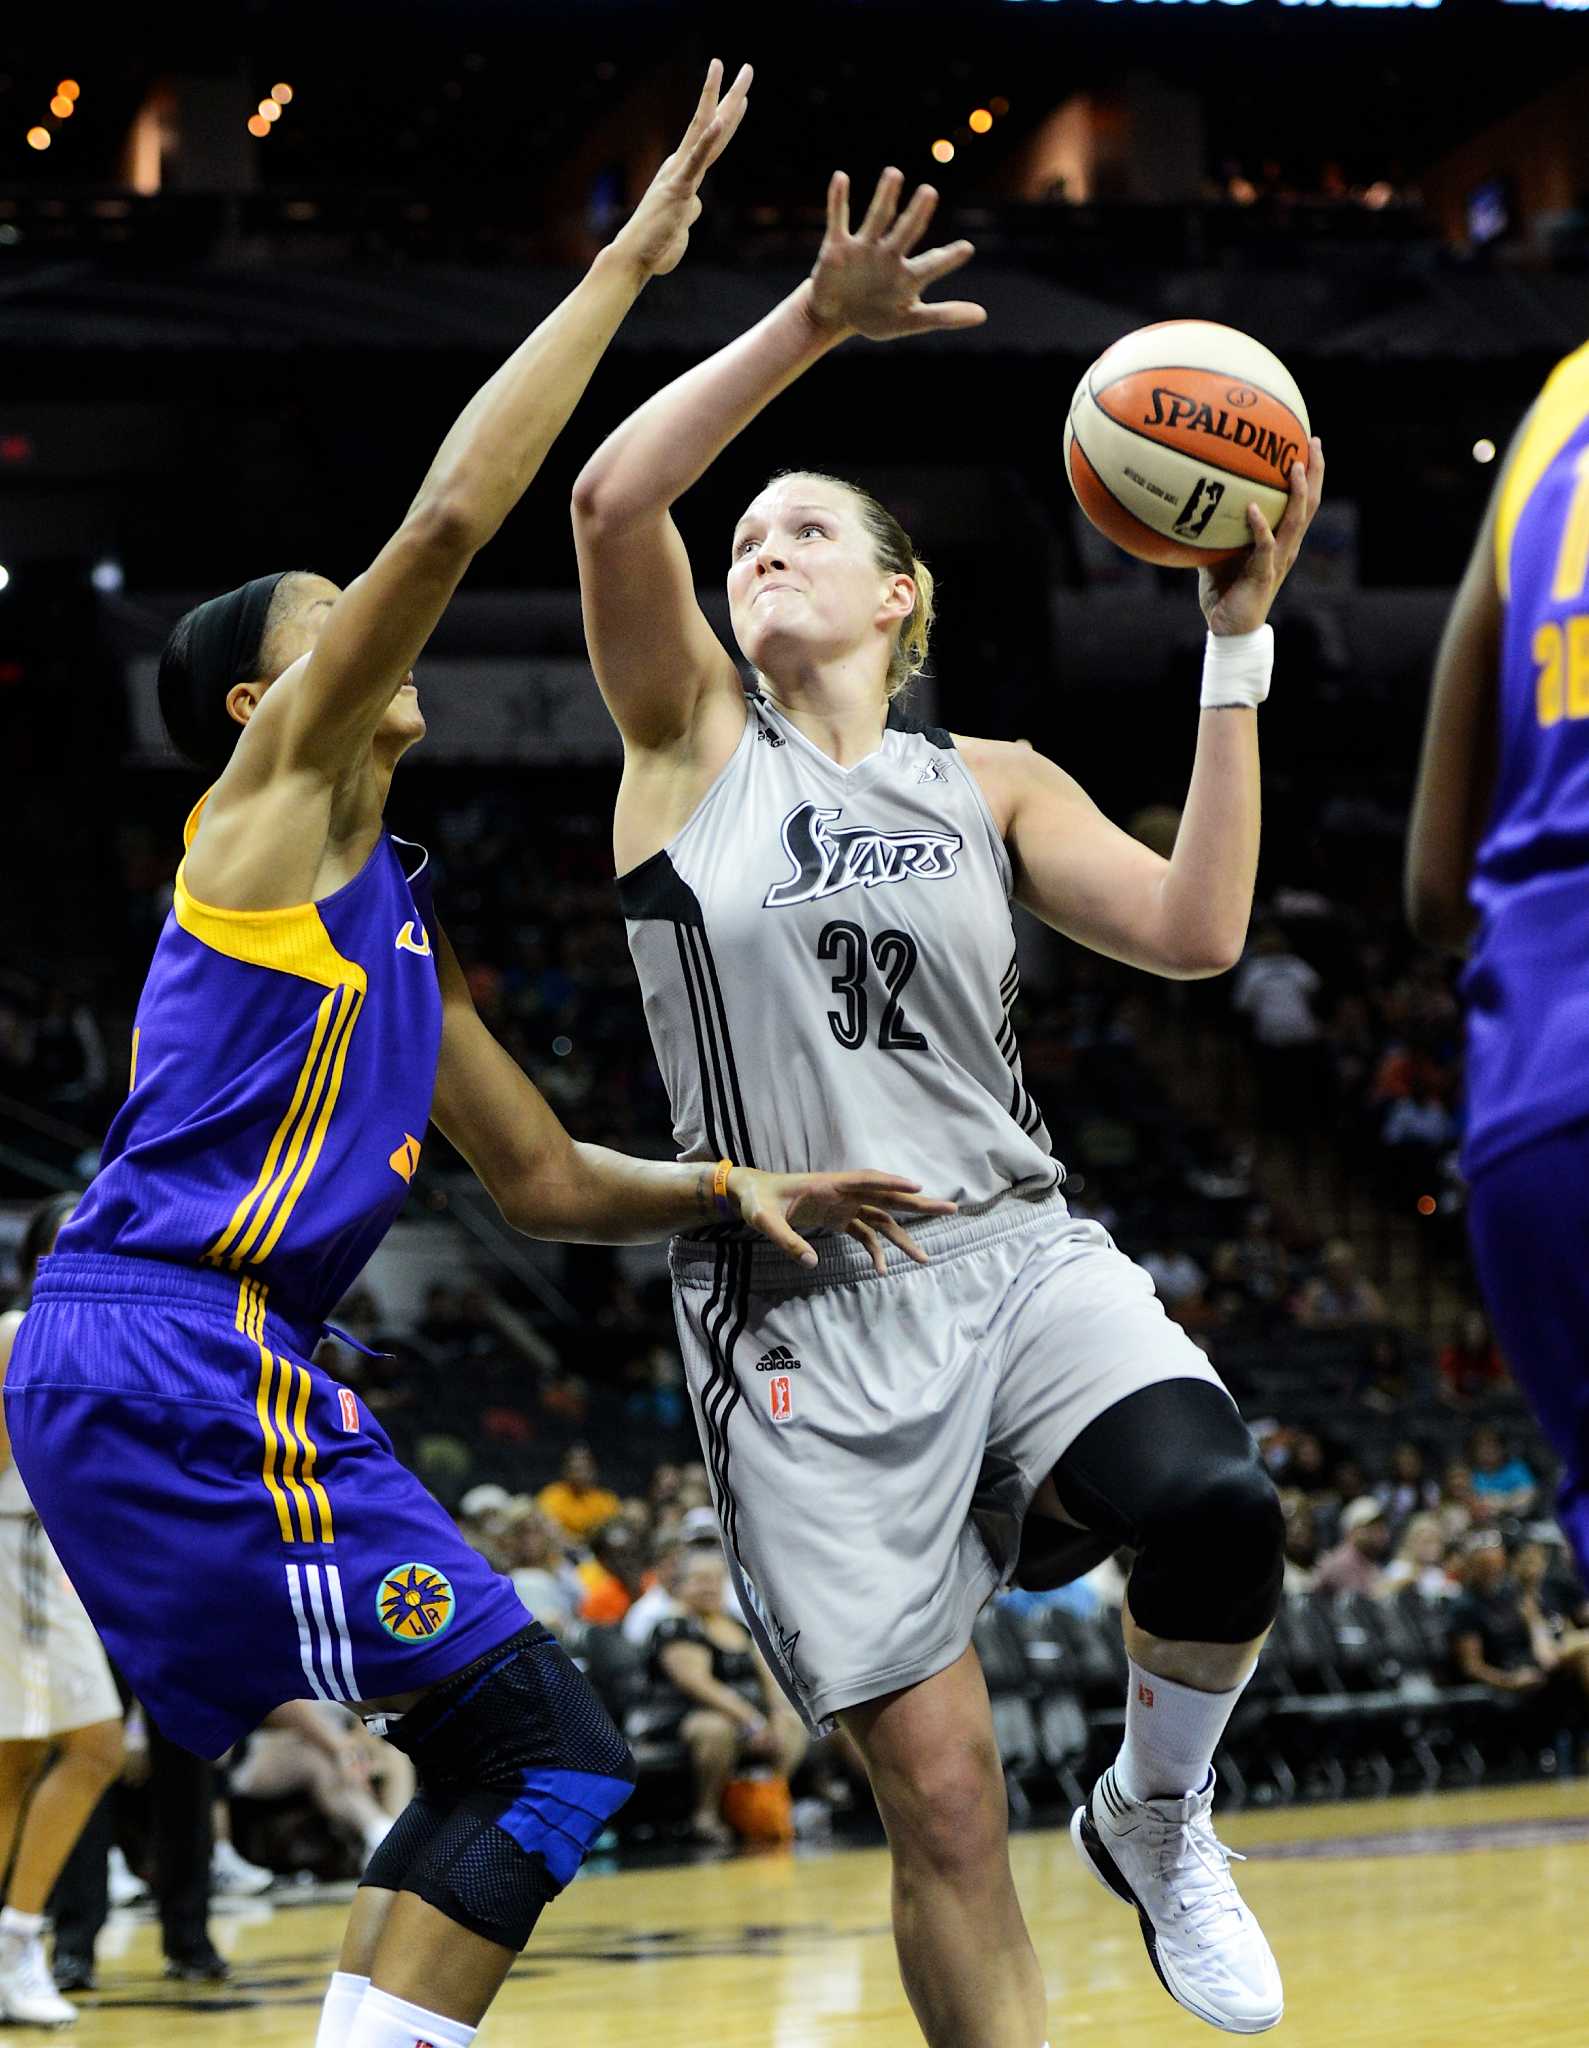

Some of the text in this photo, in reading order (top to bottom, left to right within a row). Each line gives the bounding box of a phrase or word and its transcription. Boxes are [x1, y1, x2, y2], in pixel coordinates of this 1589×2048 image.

[1144, 387, 1298, 480] SPALDING
[763, 801, 962, 908] STARS
[817, 920, 928, 1051] 32
[756, 1359, 801, 1371] adidas
